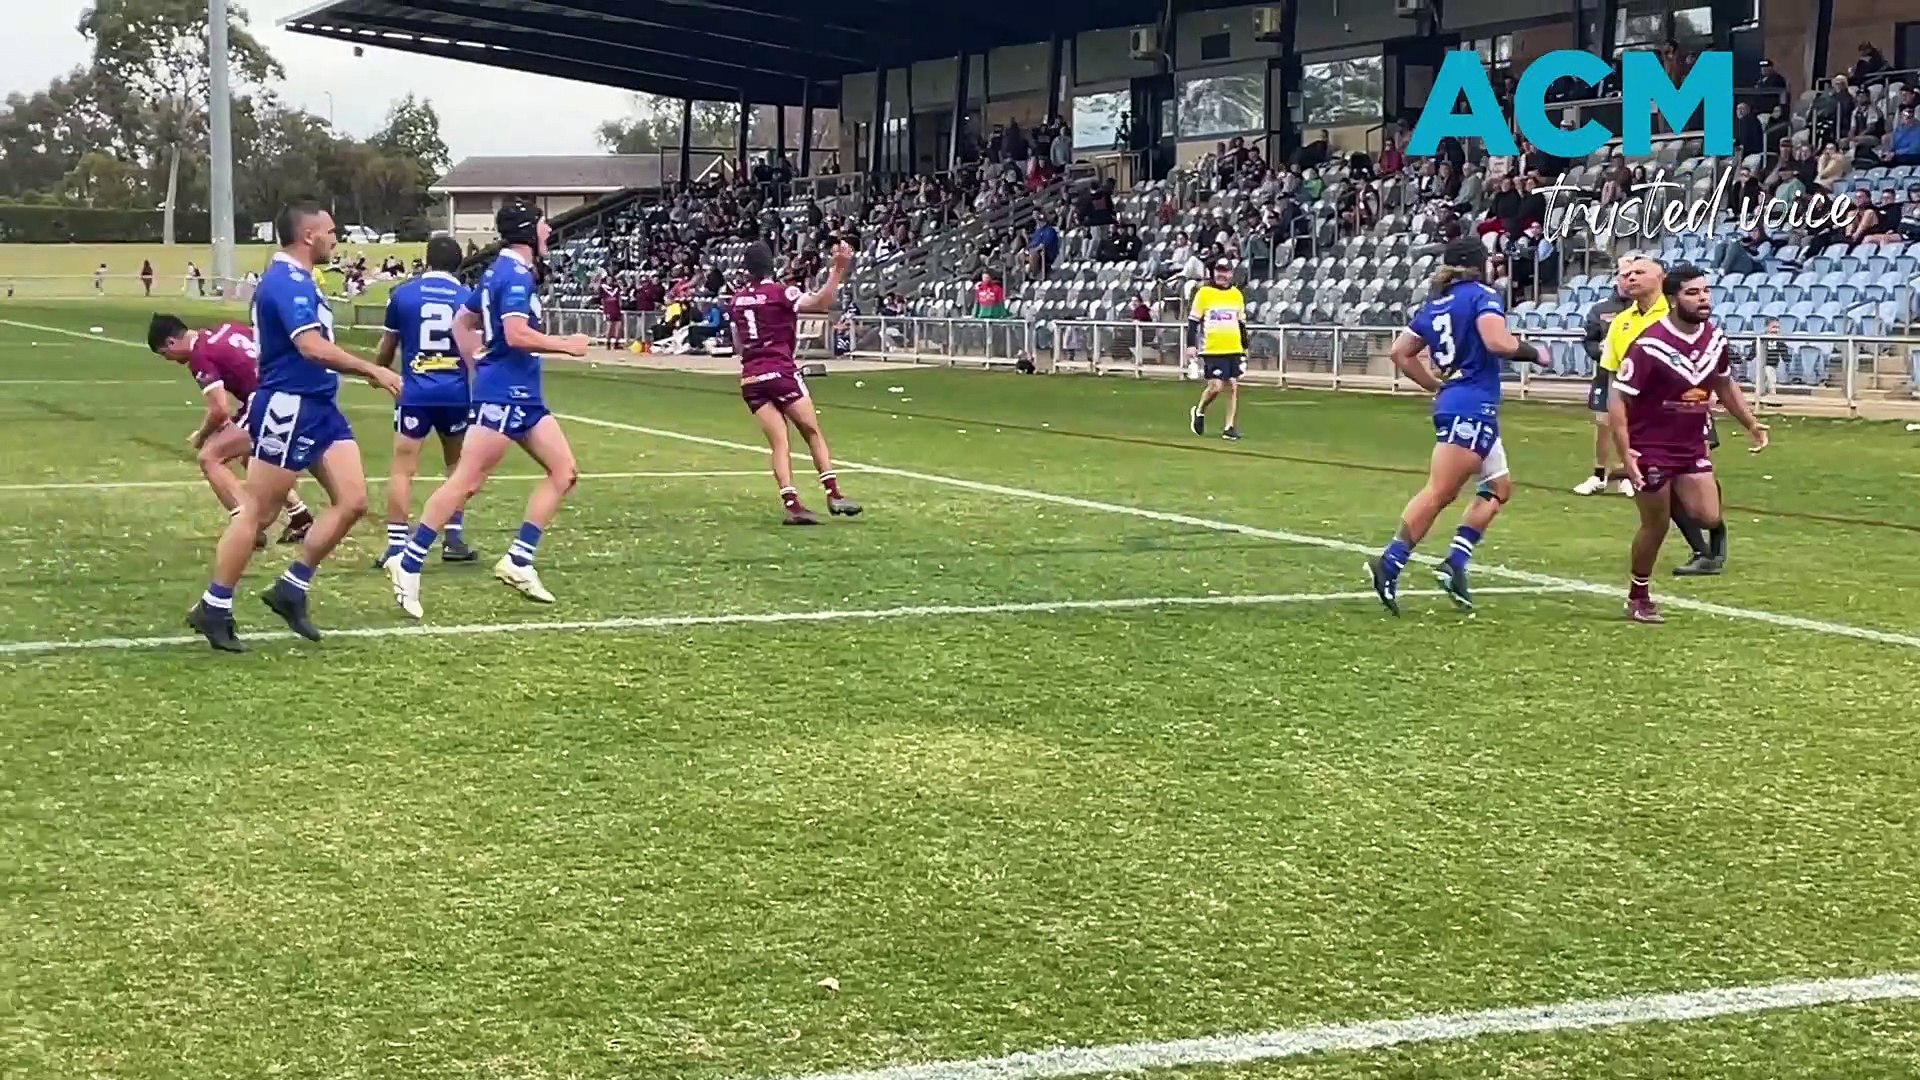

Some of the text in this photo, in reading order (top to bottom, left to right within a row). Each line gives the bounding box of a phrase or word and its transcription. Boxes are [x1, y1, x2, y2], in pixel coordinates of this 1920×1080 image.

[420, 303, 453, 350] 2
[743, 309, 759, 340] 1
[1432, 313, 1456, 366] 3
